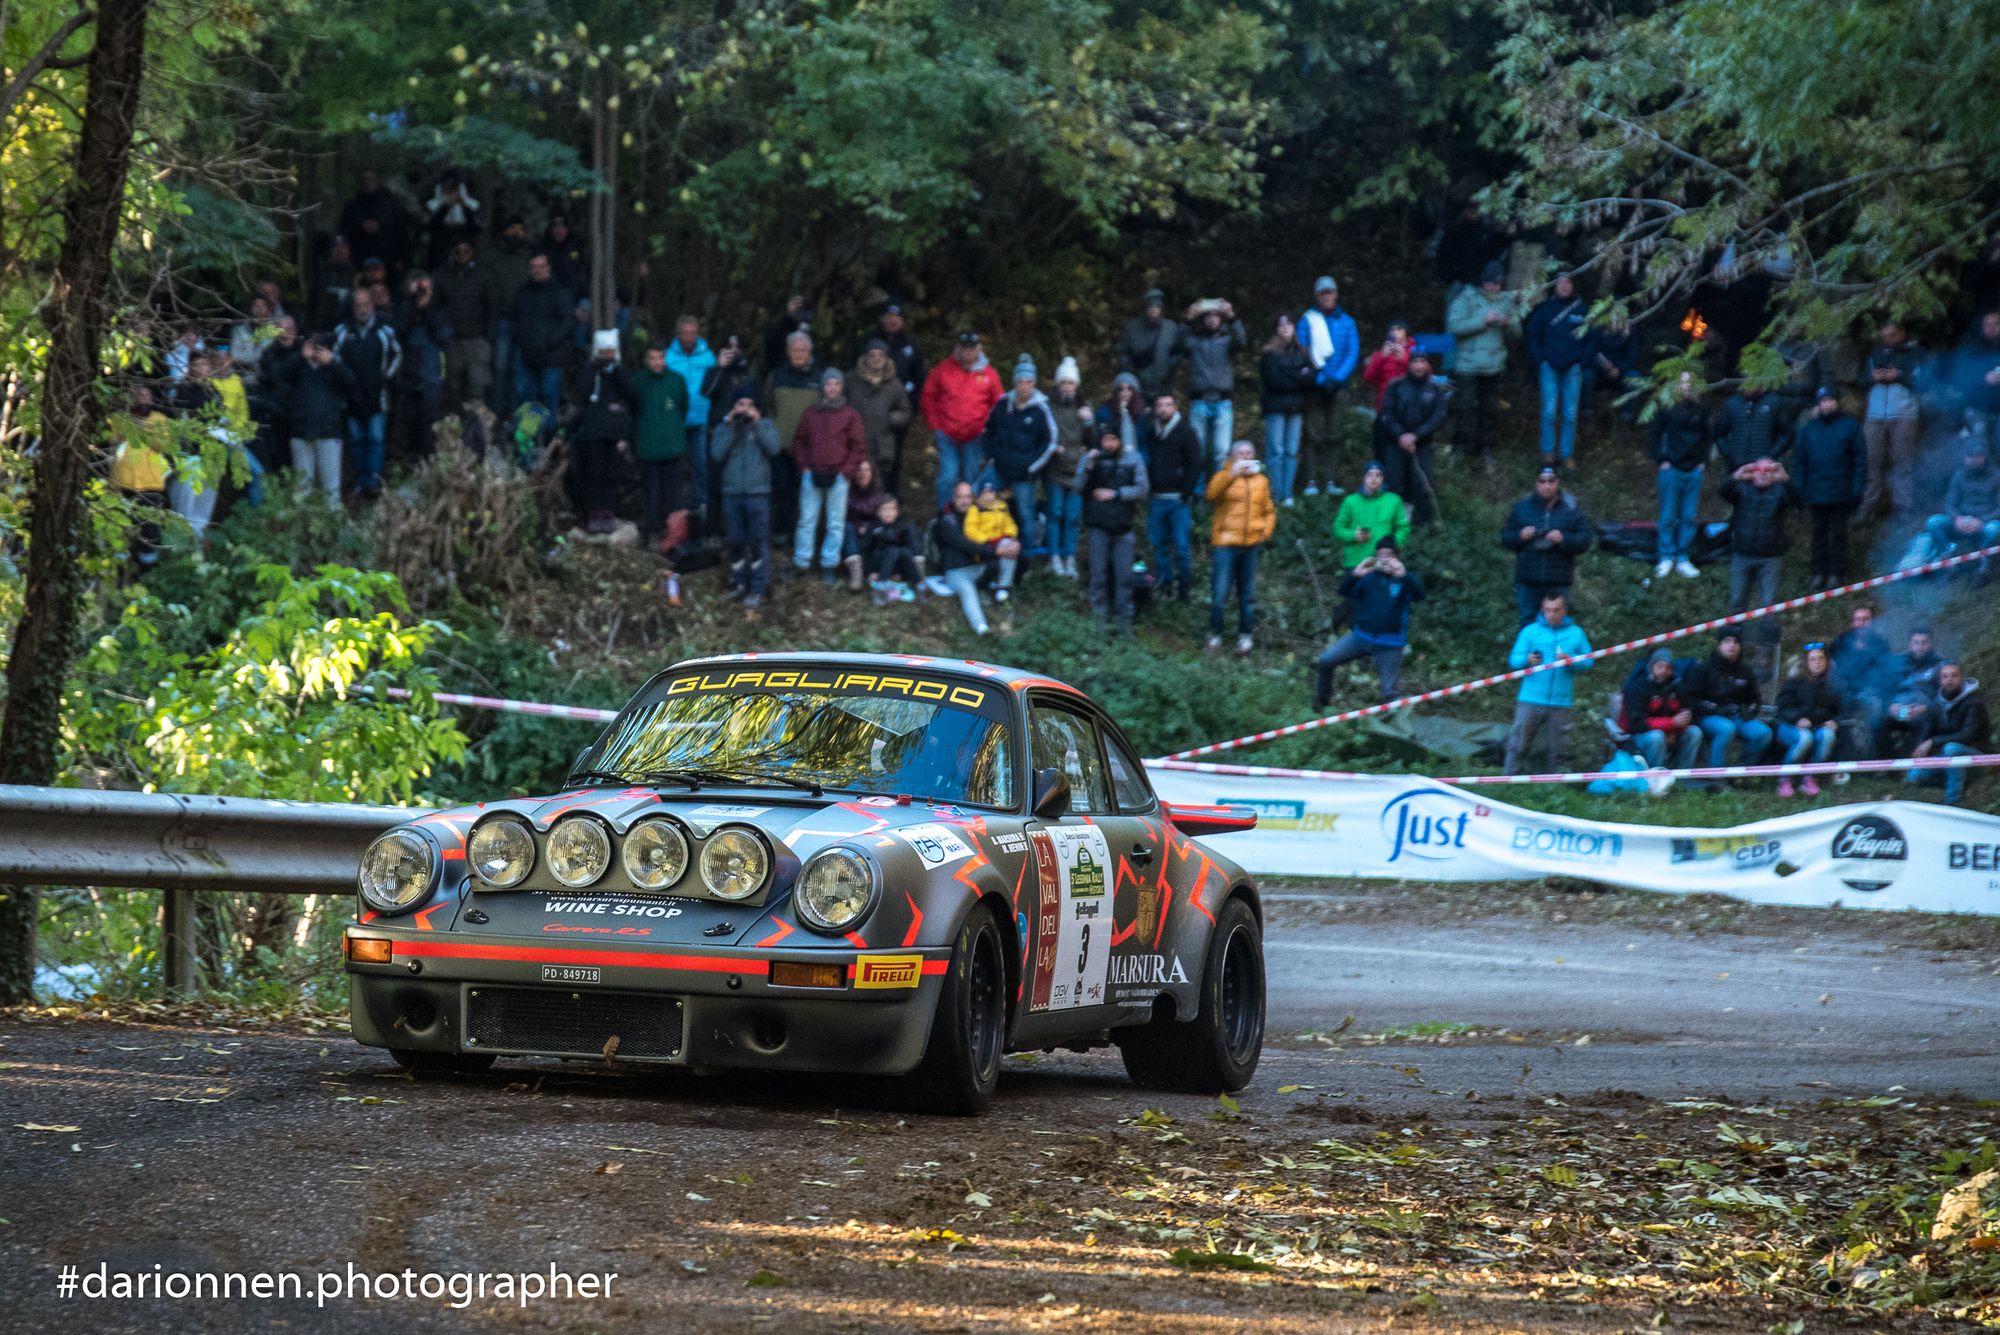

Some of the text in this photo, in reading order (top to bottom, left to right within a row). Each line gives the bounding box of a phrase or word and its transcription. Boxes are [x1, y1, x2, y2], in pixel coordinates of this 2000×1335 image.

[667, 672, 985, 708] GUAGLIARDO
[1387, 803, 1471, 862] Just
[1042, 884, 1058, 905] VAL
[544, 902, 683, 918] WINE SHOP
[611, 926, 654, 936] RS
[1042, 915, 1056, 936] DEL
[1077, 923, 1091, 974] 3
[863, 962, 916, 982] PIRELLI
[1107, 954, 1190, 984] MARSURA
